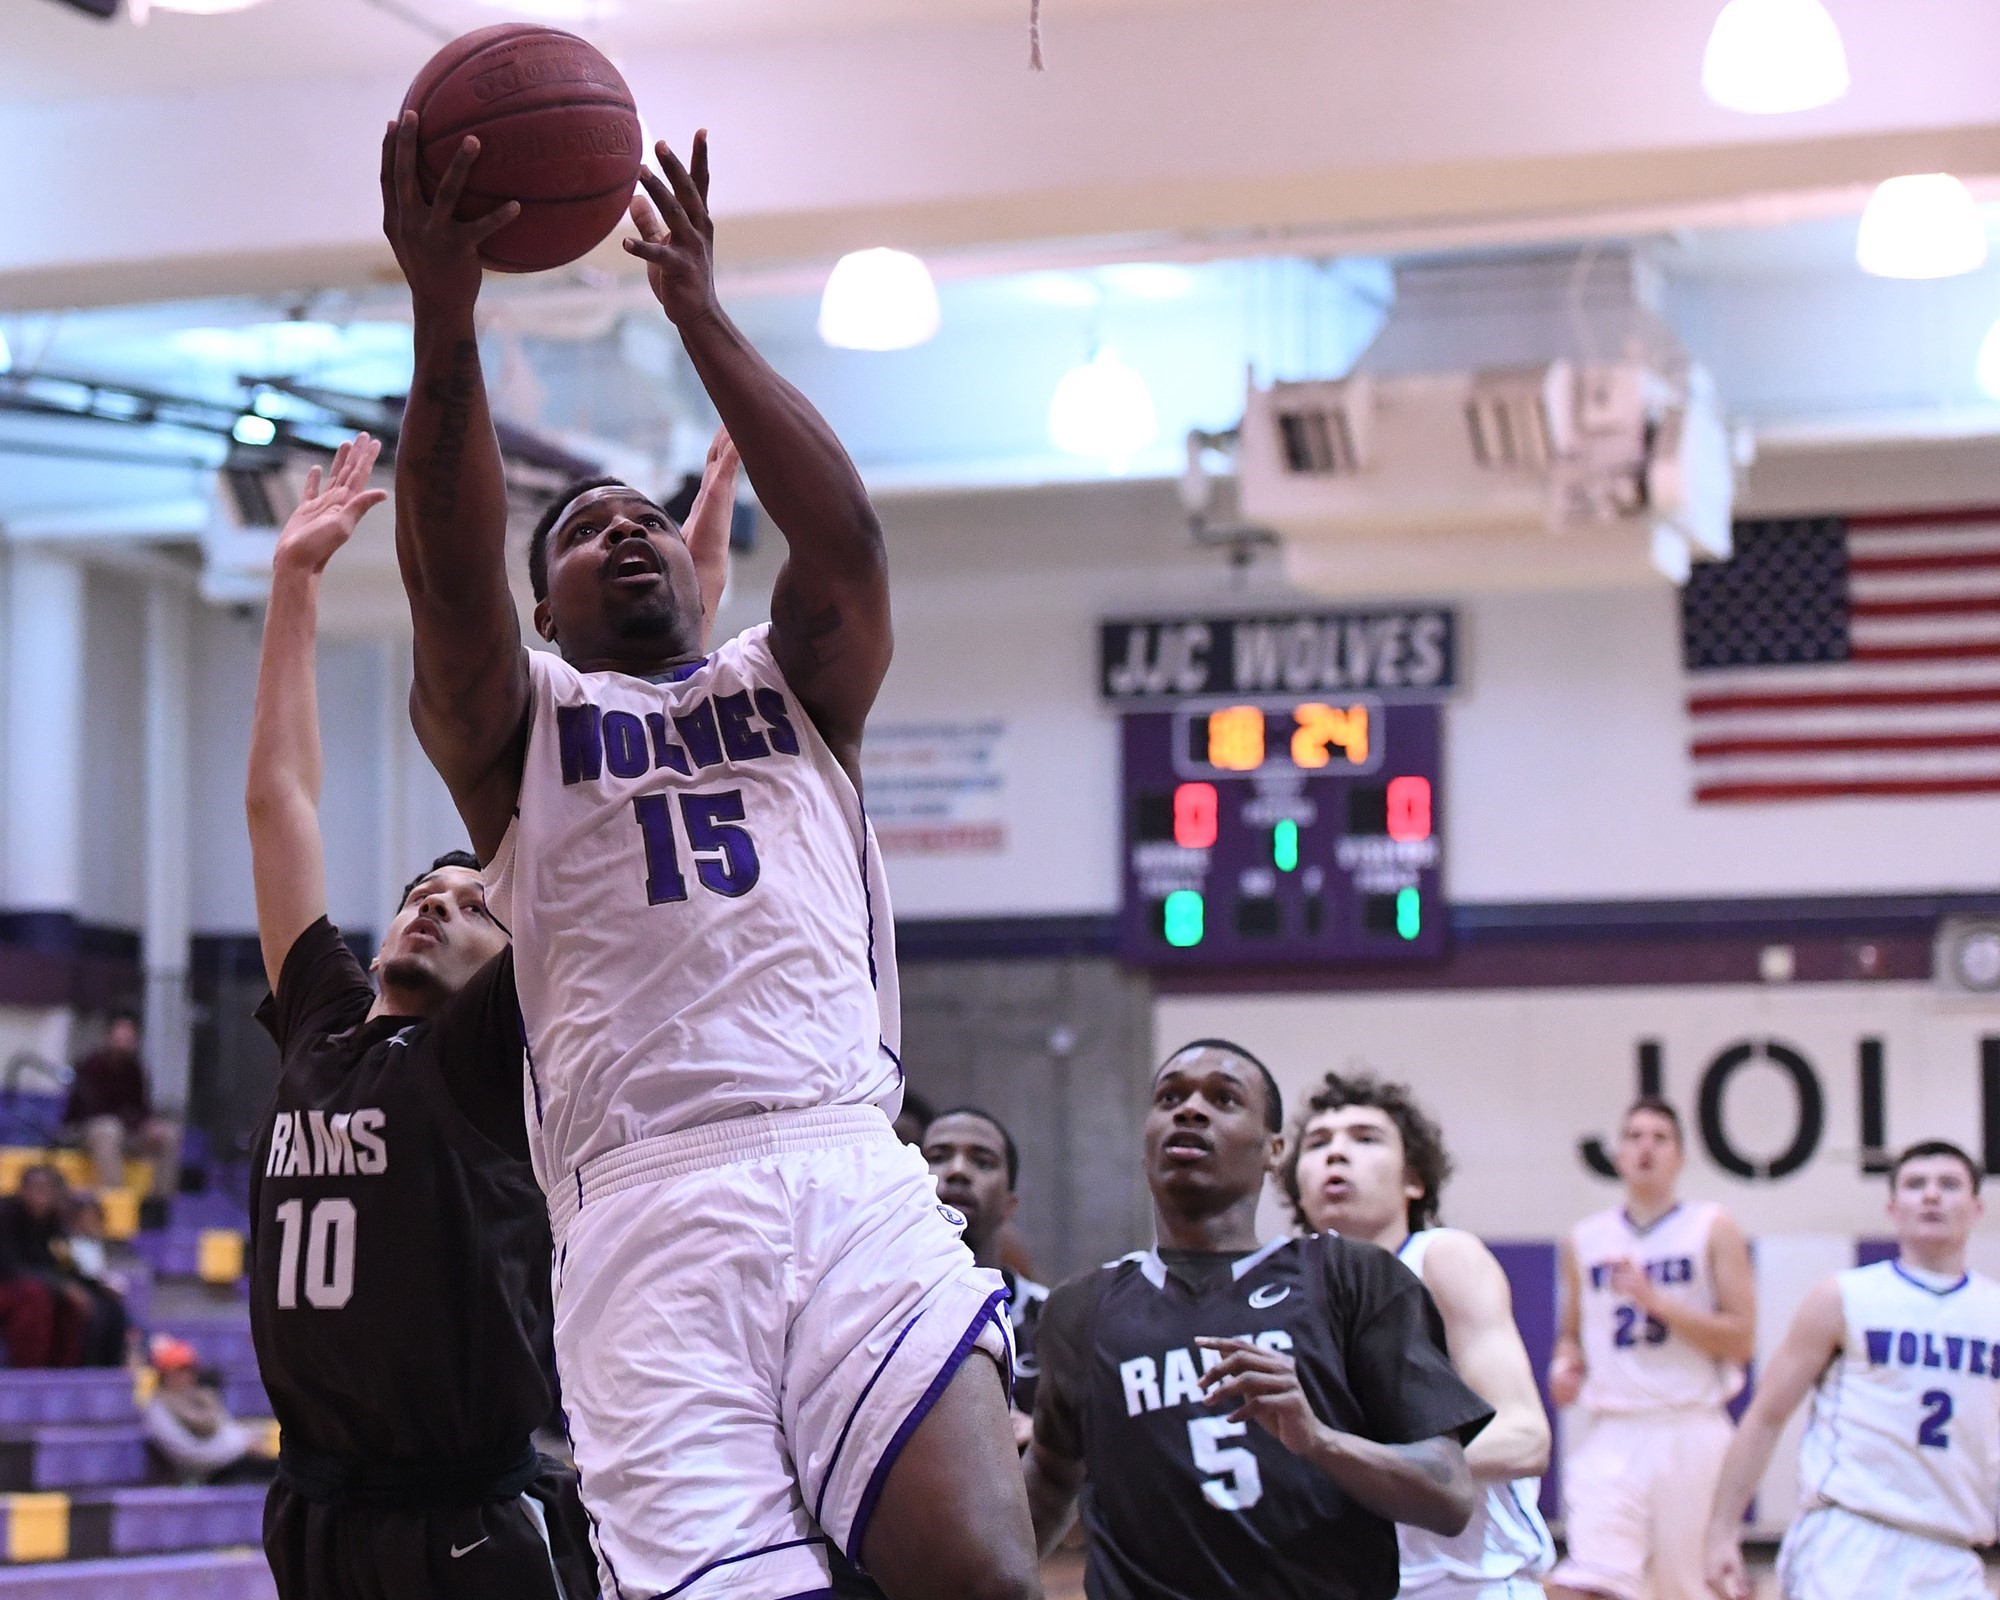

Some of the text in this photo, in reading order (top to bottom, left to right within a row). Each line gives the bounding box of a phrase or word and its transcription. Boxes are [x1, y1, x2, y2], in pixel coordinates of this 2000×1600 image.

[1232, 615, 1446, 690] WOLVES
[557, 687, 800, 785] WOLVES
[1174, 782, 1218, 849] 0
[1386, 776, 1431, 842] 0
[633, 789, 761, 906] 15
[1396, 886, 1420, 940] 1
[265, 1107, 388, 1177] RAMS
[275, 1197, 358, 1310] 10
[1918, 1389, 1953, 1448] 2
[1186, 1412, 1264, 1512] 5
